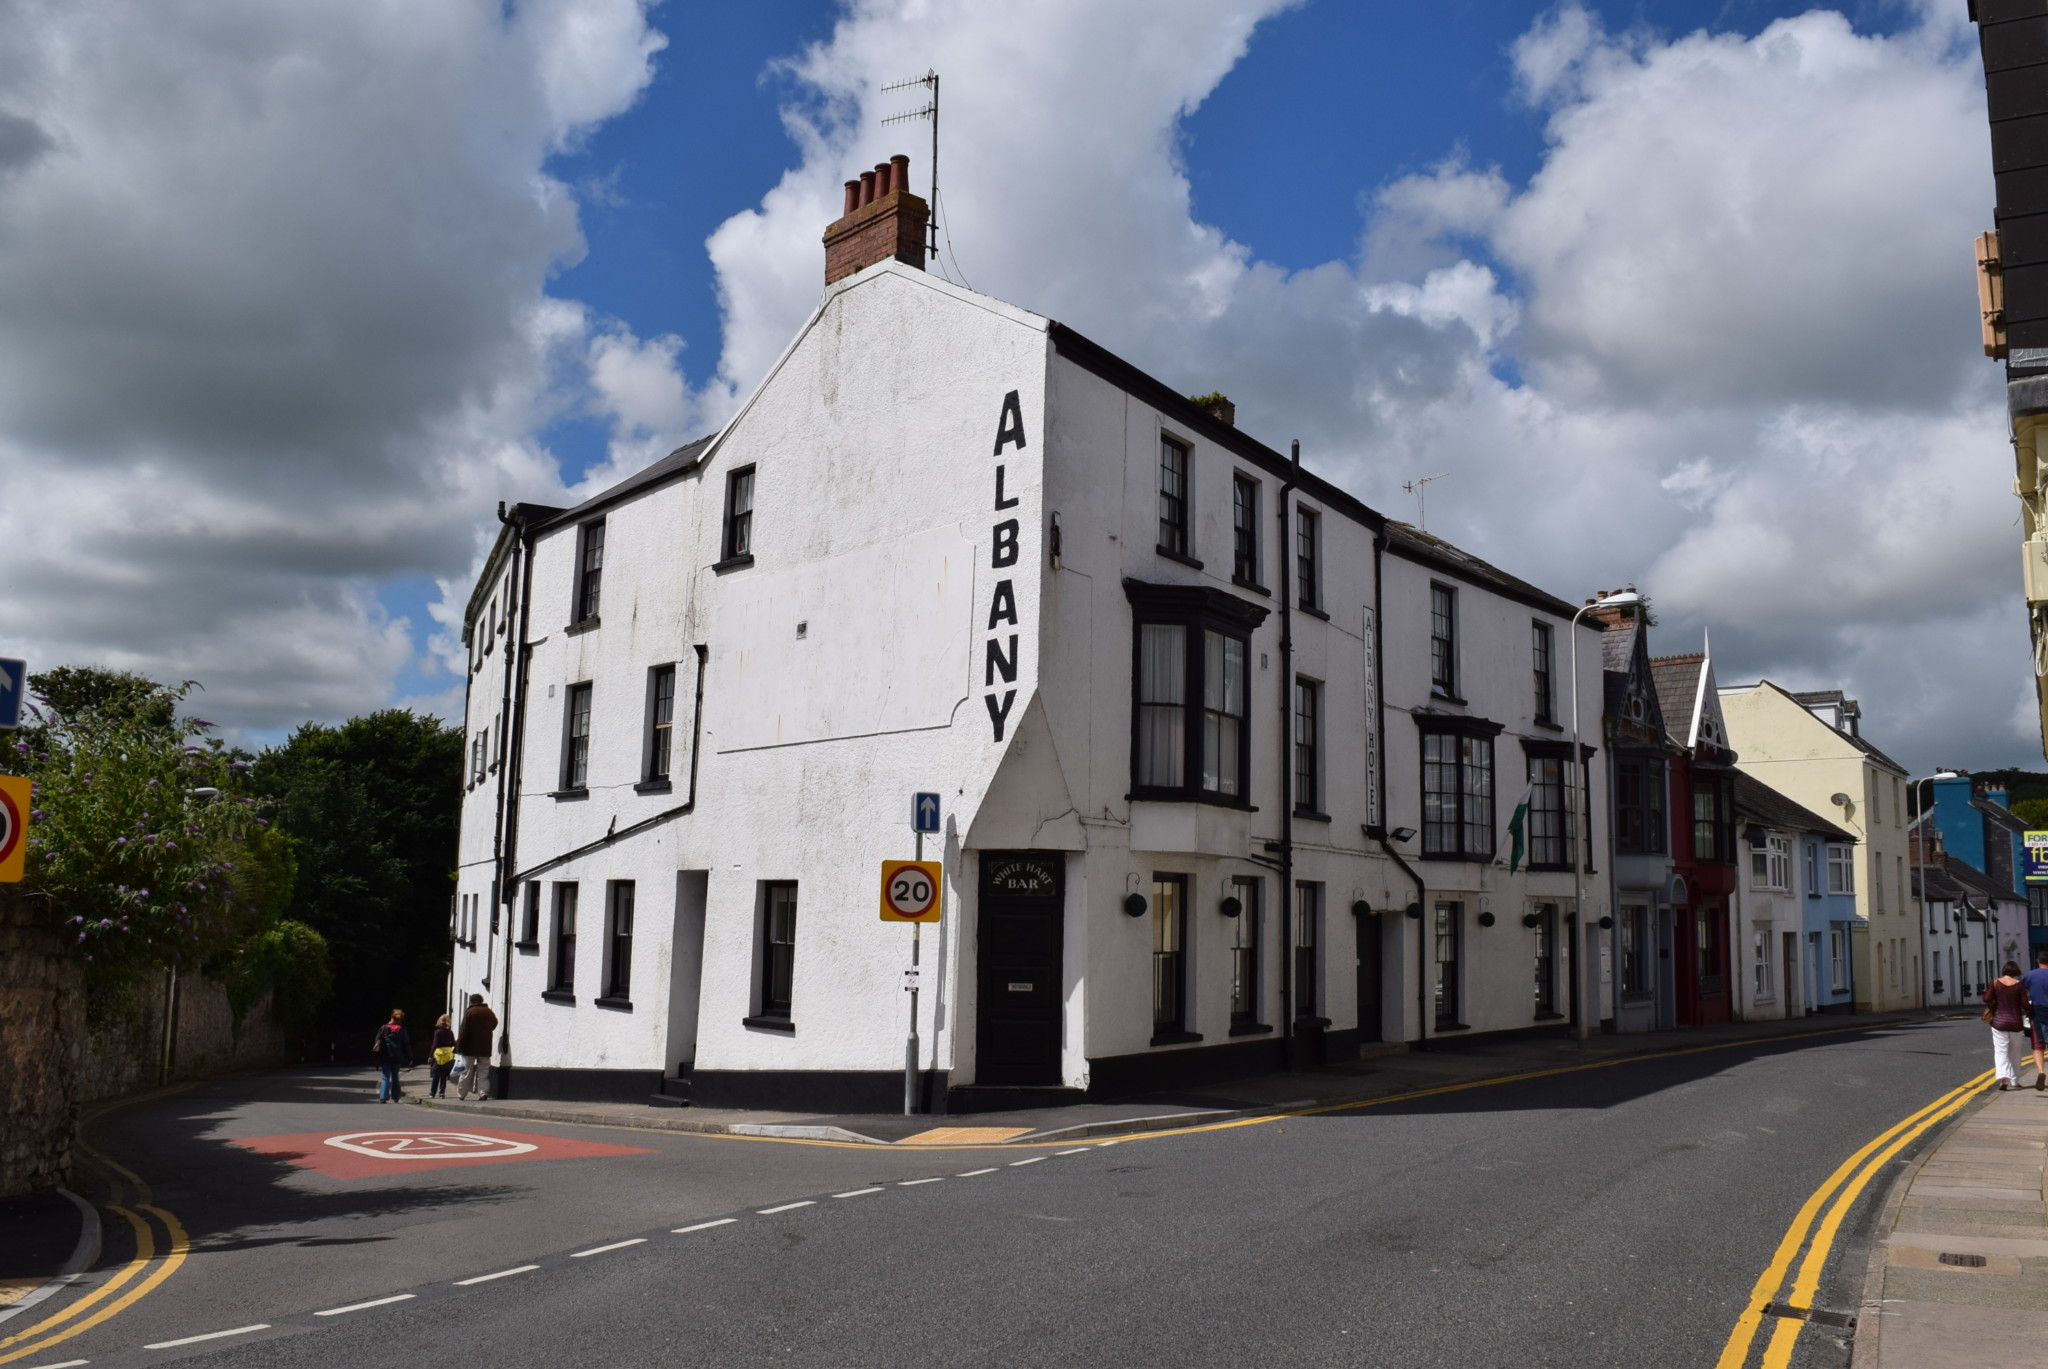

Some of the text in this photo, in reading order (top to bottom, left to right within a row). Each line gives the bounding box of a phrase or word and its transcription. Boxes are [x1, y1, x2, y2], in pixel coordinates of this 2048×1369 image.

[984, 389, 1027, 743] ALBANY
[1365, 615, 1376, 825] ALBANY HOTEL
[2027, 834, 2048, 842] FOR
[992, 862, 1053, 885] WHITE HART
[1008, 878, 1039, 889] BAR
[894, 880, 930, 902] 20
[361, 1136, 494, 1151] 20
